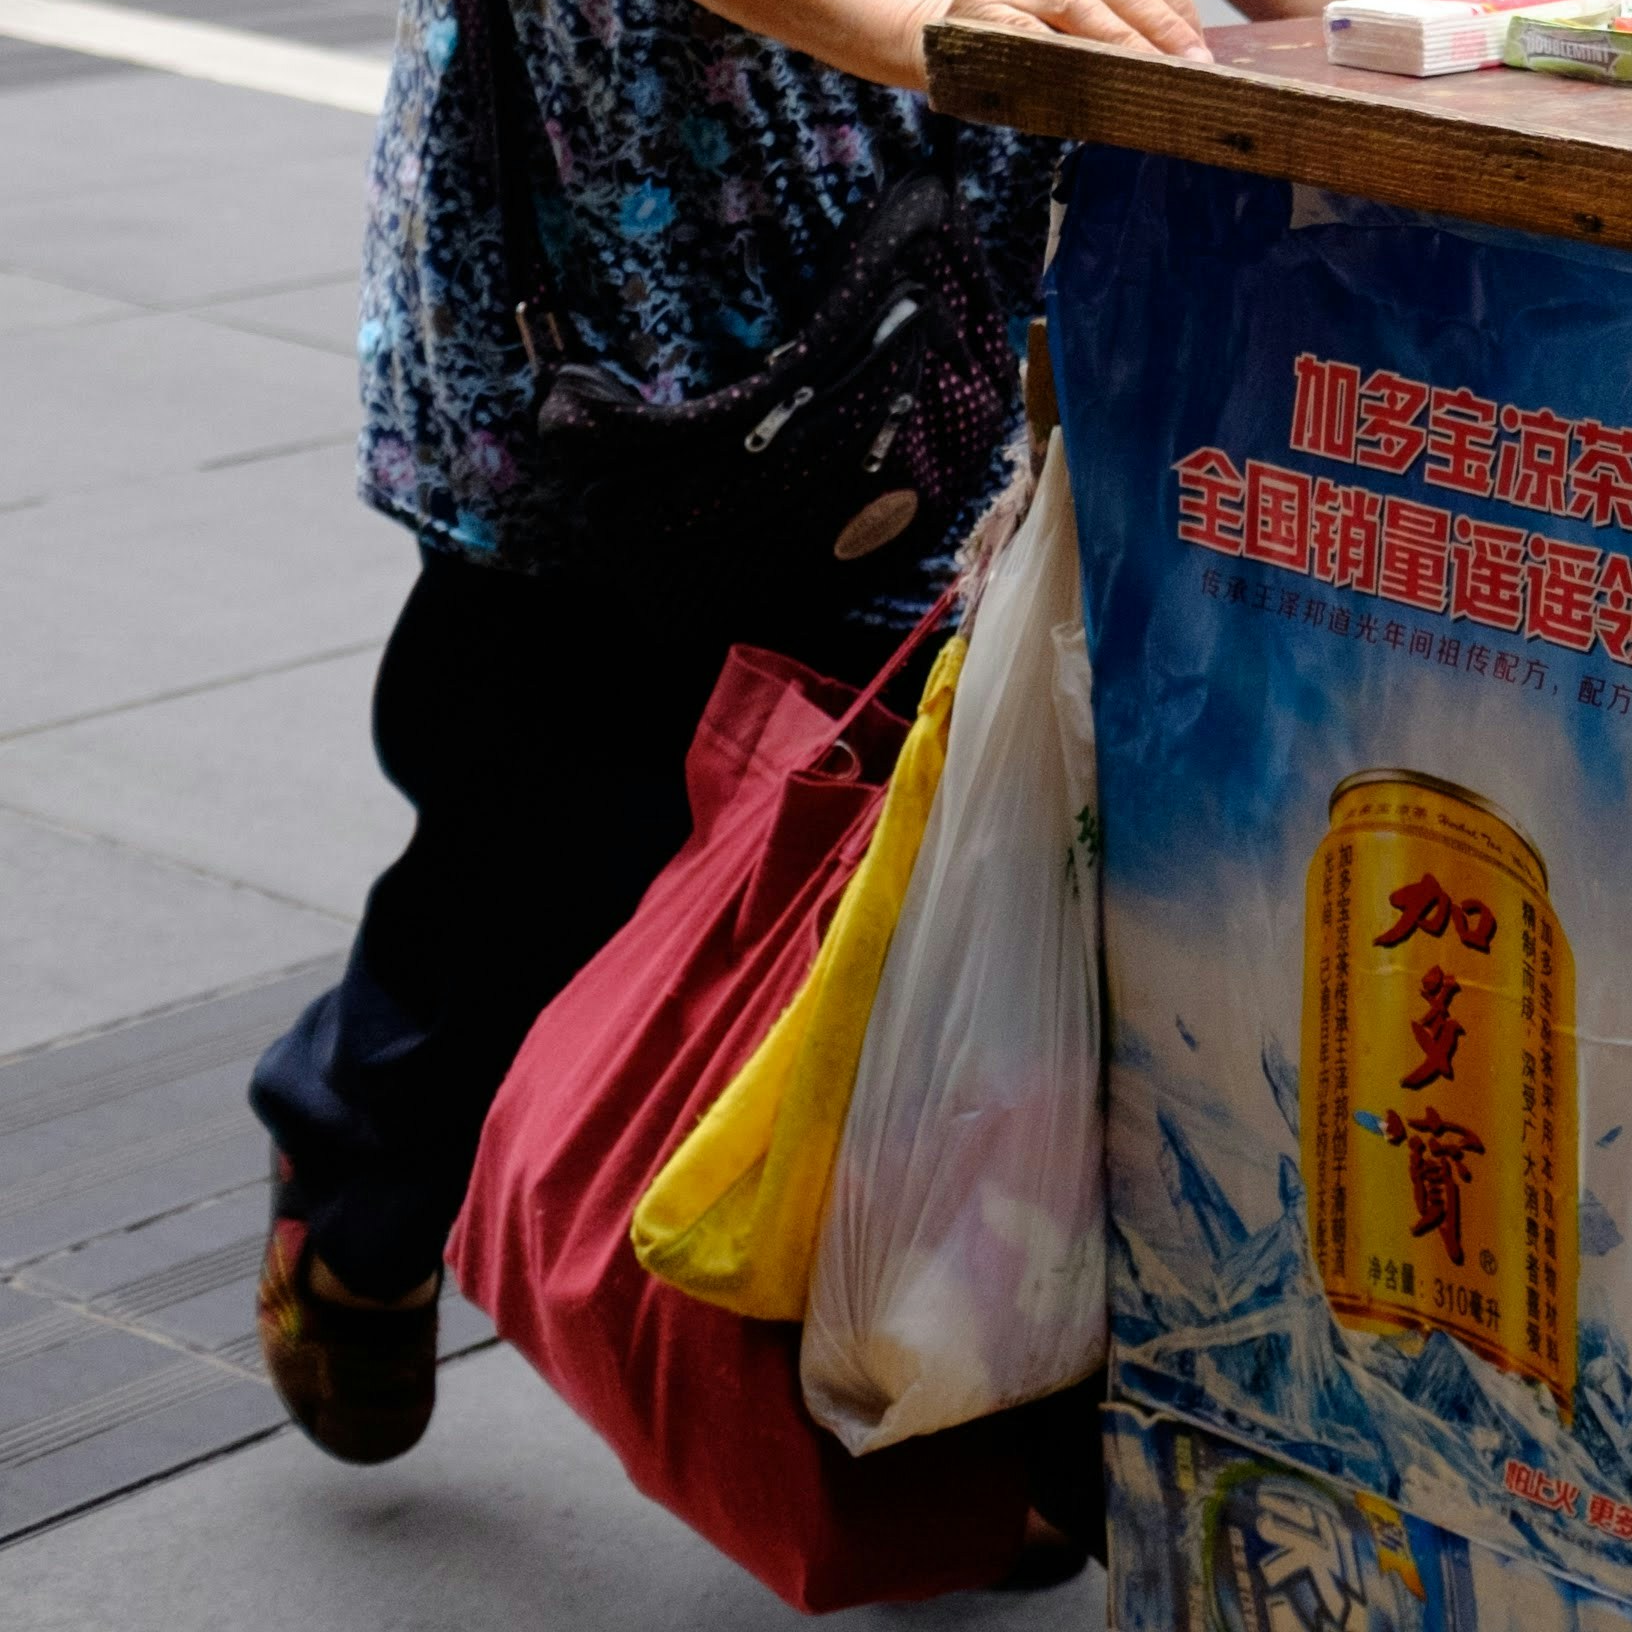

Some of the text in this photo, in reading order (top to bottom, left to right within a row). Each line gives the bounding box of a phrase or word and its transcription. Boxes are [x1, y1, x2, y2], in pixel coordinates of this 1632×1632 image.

[1526, 31, 1611, 66] DOUBLEMINT
[1503, 1458, 1581, 1517] 怕上火
